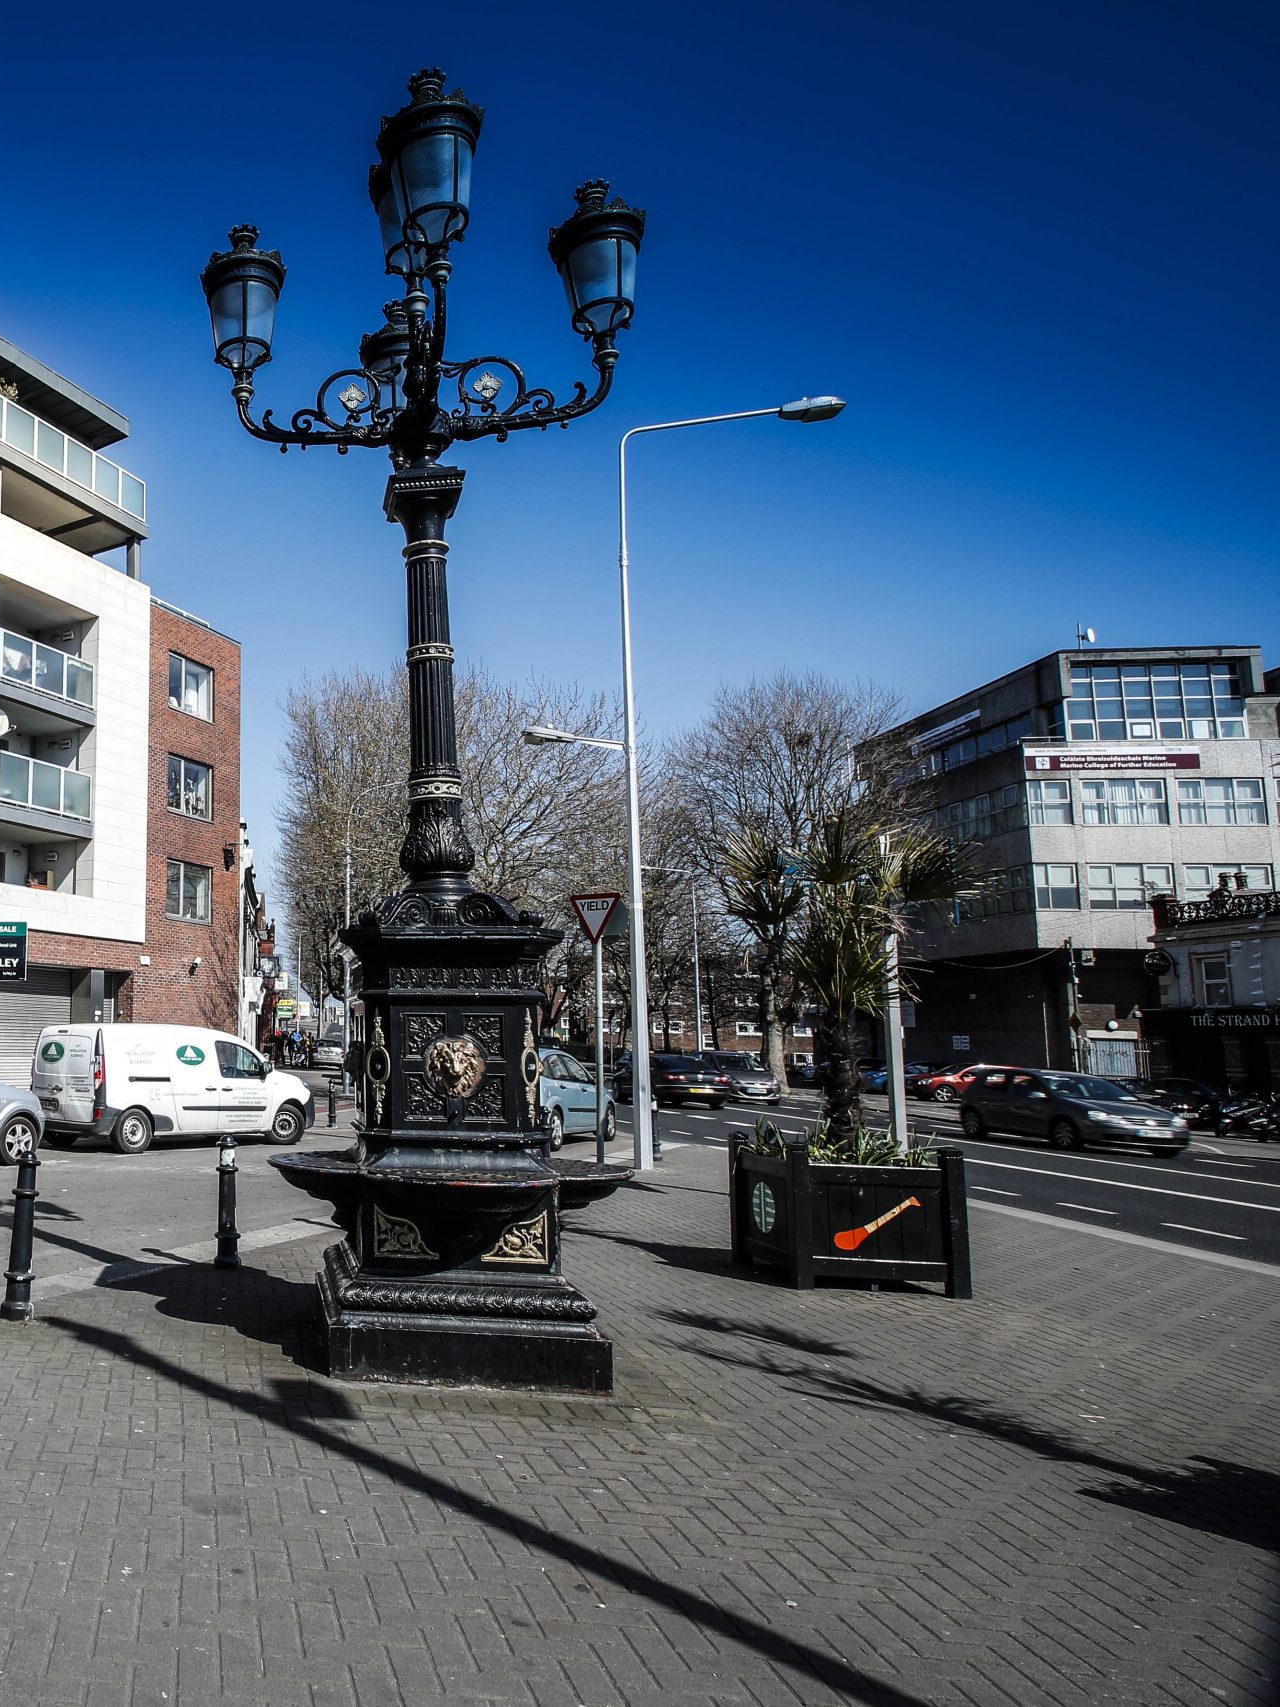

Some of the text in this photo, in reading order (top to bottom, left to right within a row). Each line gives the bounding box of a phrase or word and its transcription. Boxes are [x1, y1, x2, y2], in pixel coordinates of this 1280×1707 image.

[580, 900, 609, 911] YIELD
[1190, 1015, 1215, 1027] THE
[1218, 1014, 1270, 1027] STRAND
